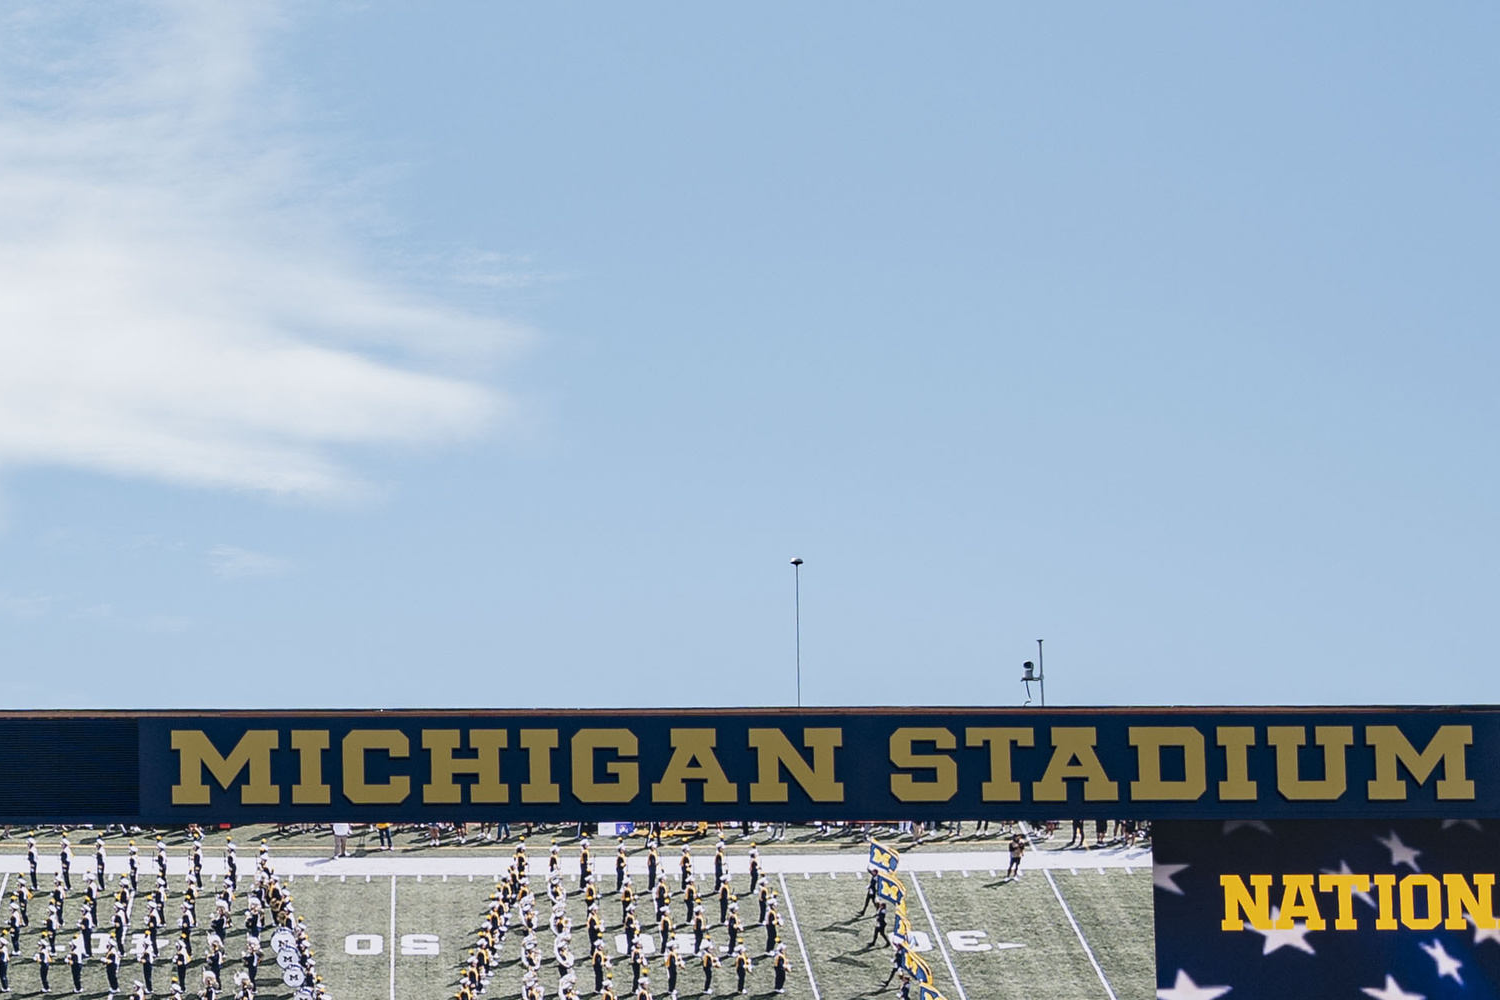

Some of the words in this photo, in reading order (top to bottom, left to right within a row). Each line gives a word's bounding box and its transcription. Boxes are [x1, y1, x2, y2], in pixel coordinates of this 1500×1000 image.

[171, 728, 844, 805] MICHIGAN
[889, 725, 1475, 803] STADIUM
[872, 847, 891, 868] M
[880, 880, 899, 896] M
[1219, 873, 1499, 931] NATION
[345, 934, 440, 956] 50
